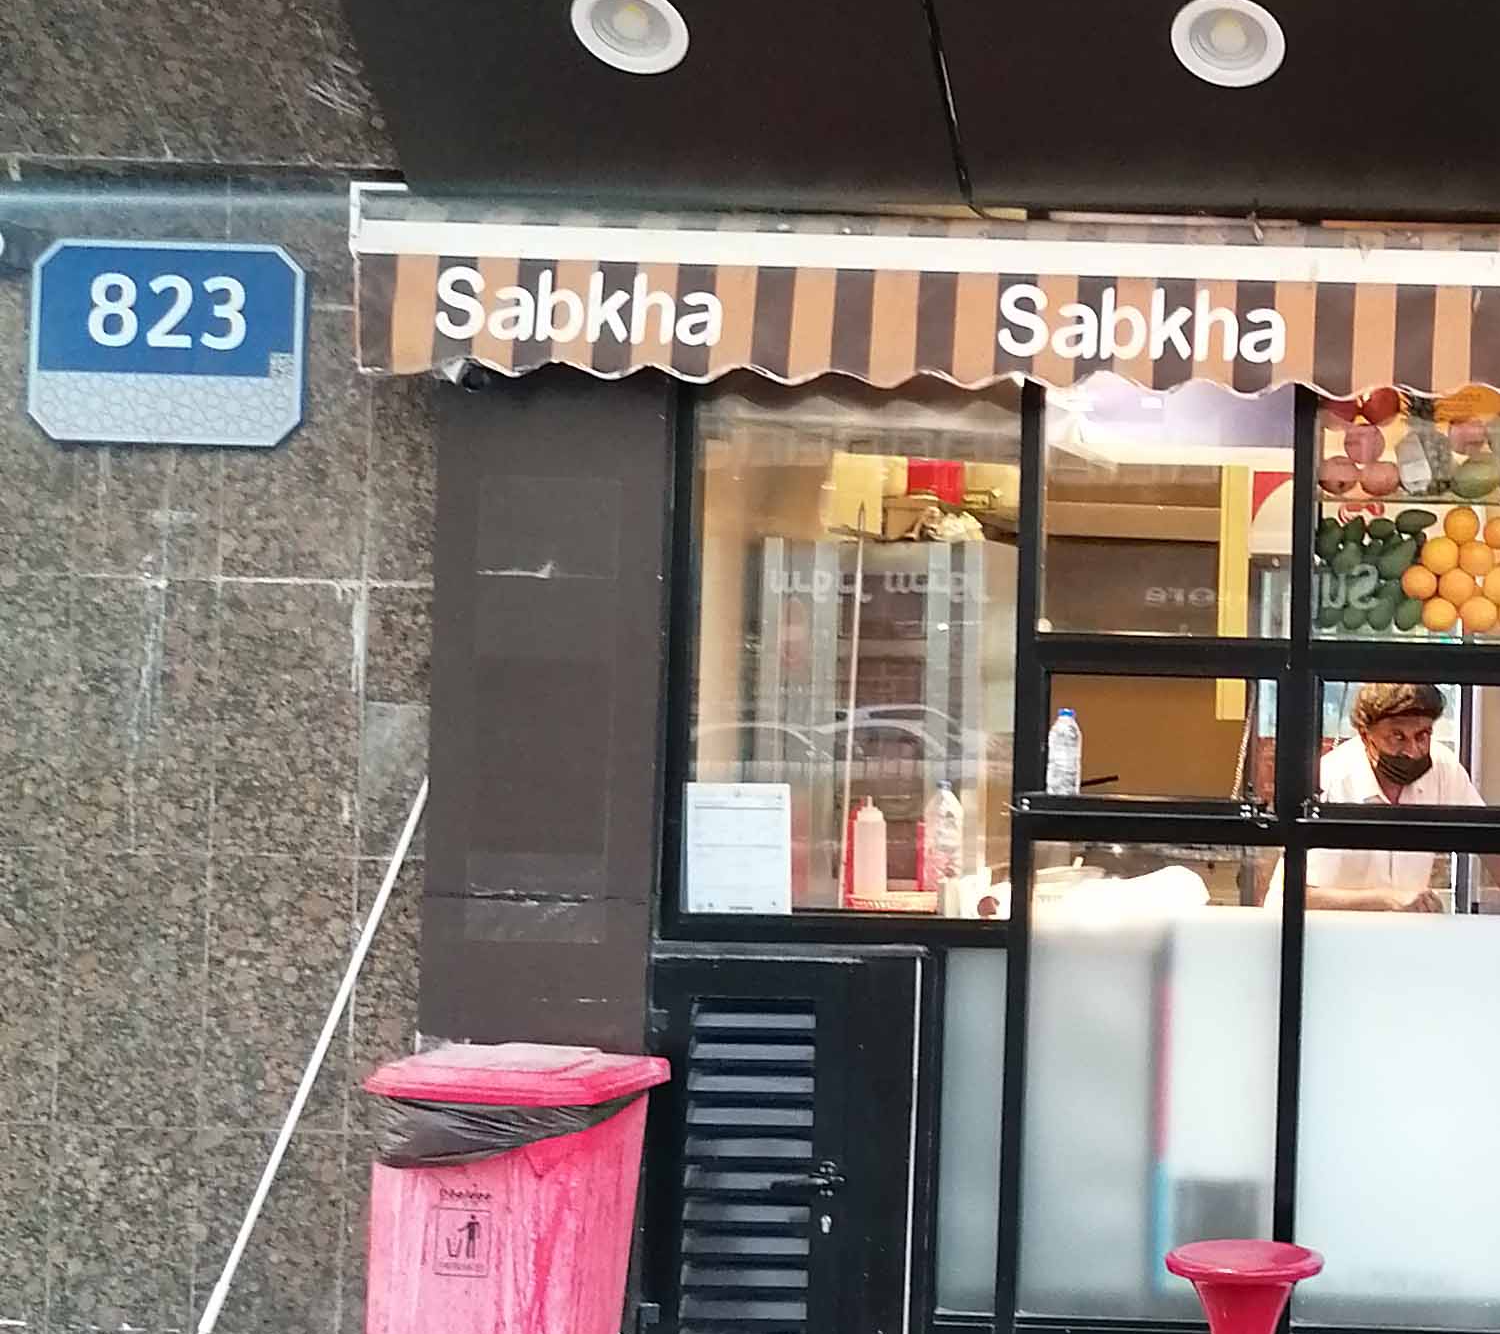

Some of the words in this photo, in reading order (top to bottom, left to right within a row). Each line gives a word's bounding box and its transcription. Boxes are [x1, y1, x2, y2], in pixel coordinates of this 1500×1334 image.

[88, 272, 247, 350] 823
[435, 266, 723, 346] Sabkha
[997, 283, 1287, 364] Sabkha
